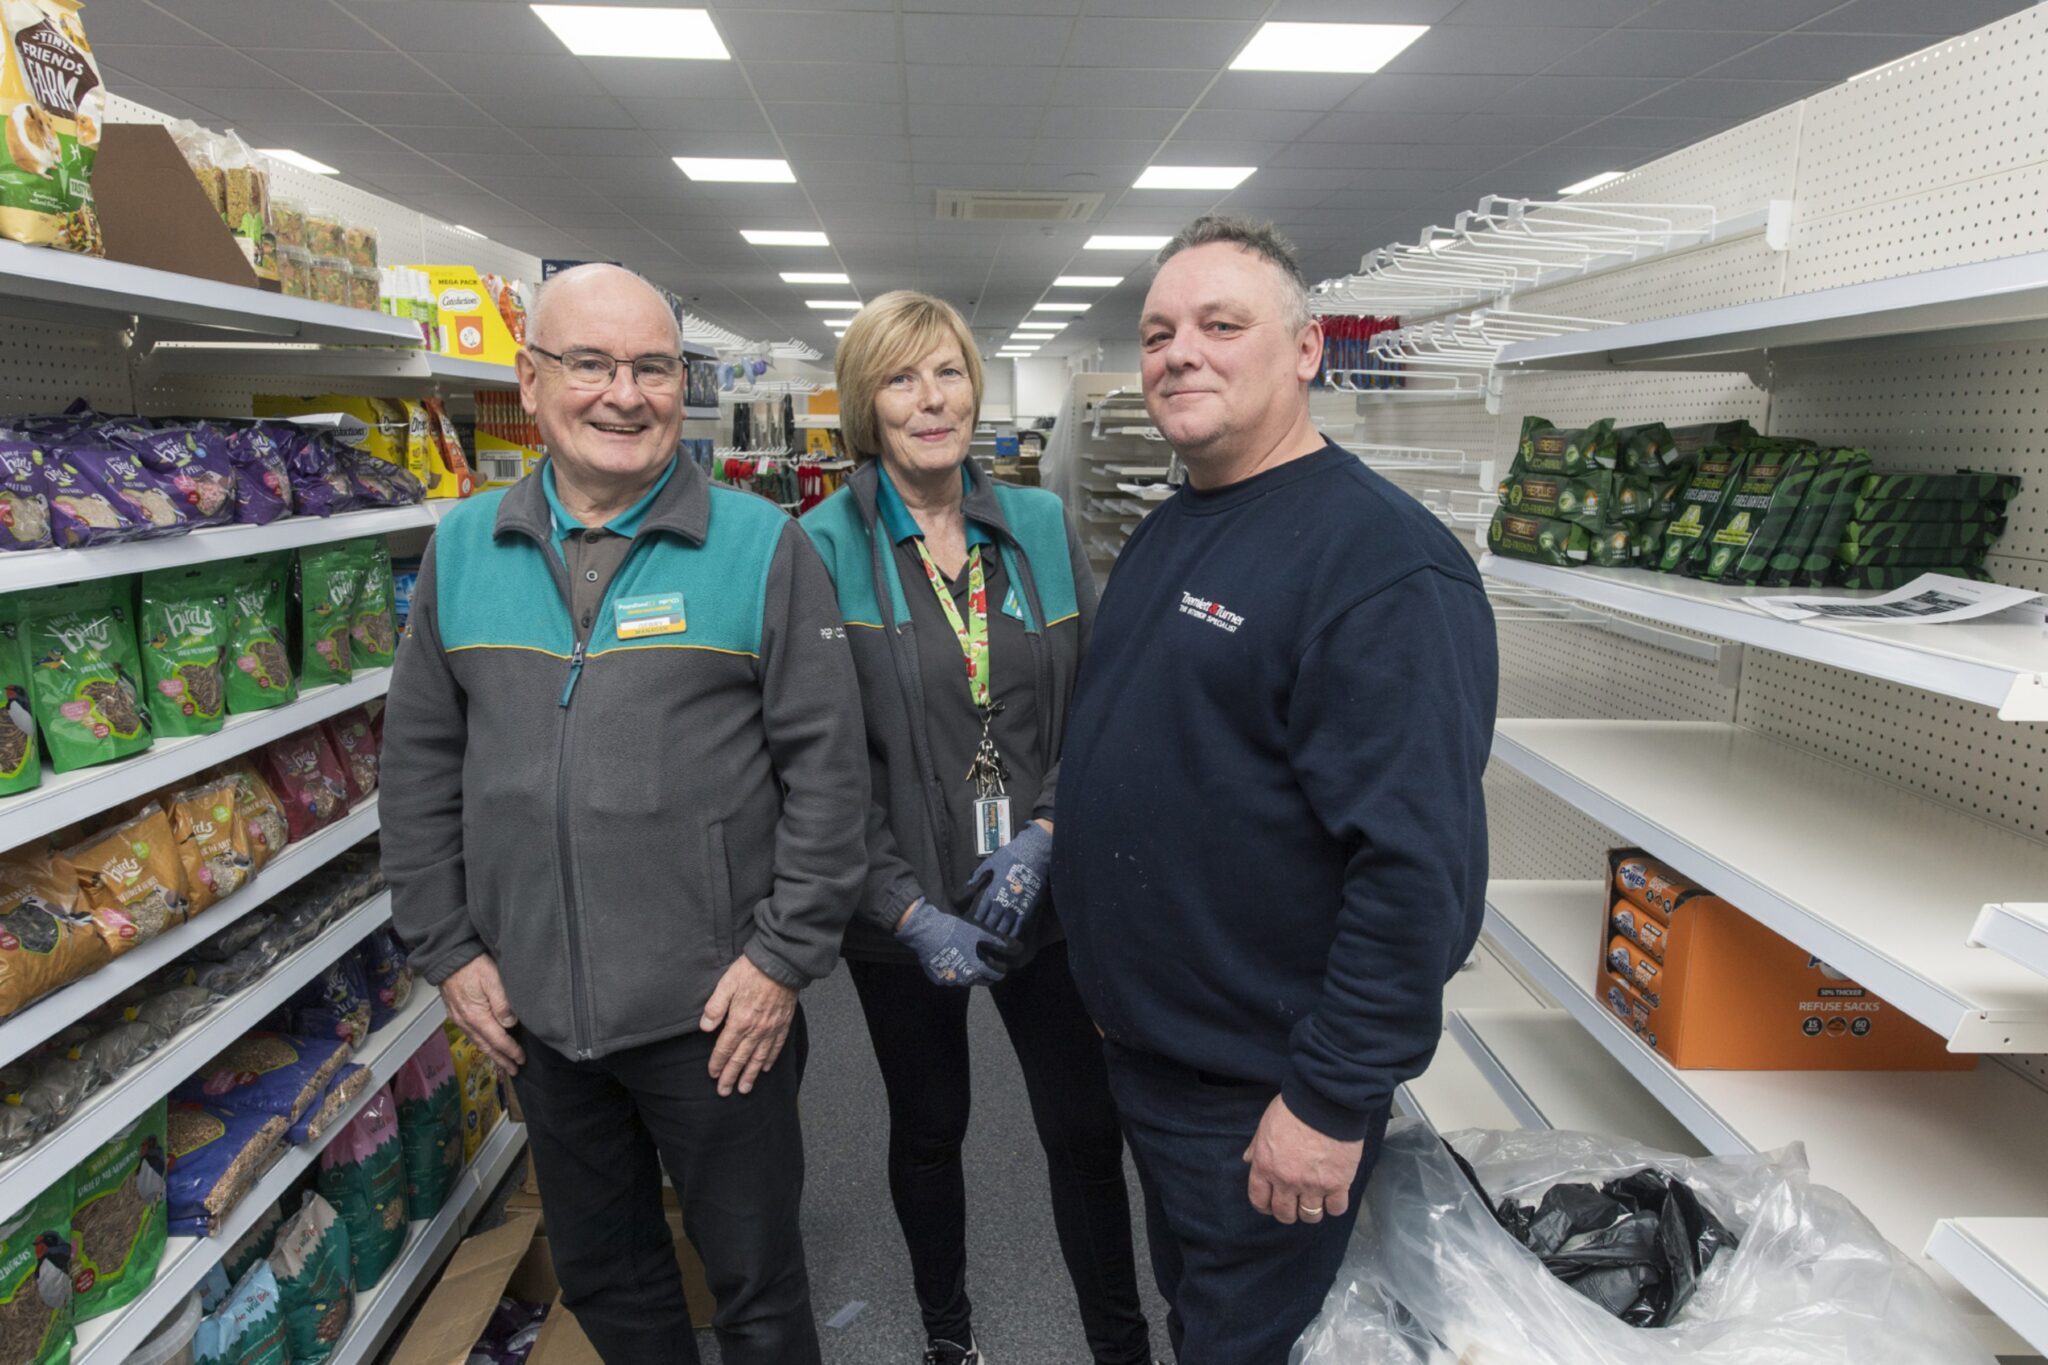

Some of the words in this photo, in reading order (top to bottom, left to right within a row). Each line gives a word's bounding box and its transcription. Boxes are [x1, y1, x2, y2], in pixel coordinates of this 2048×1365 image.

[22, 41, 84, 75] FRIENDS
[26, 57, 79, 112] FARM
[164, 605, 214, 639] birds
[1206, 615, 1238, 633] SPECIALIST
[102, 858, 139, 884] birds
[1619, 866, 1647, 888] POWER
[1799, 1001, 1841, 1011] REFUSE
[1843, 1001, 1880, 1011] SACKS
[1807, 1020, 1819, 1028] 15
[1855, 1020, 1868, 1028] 60
[77, 1175, 101, 1198] DRIED
